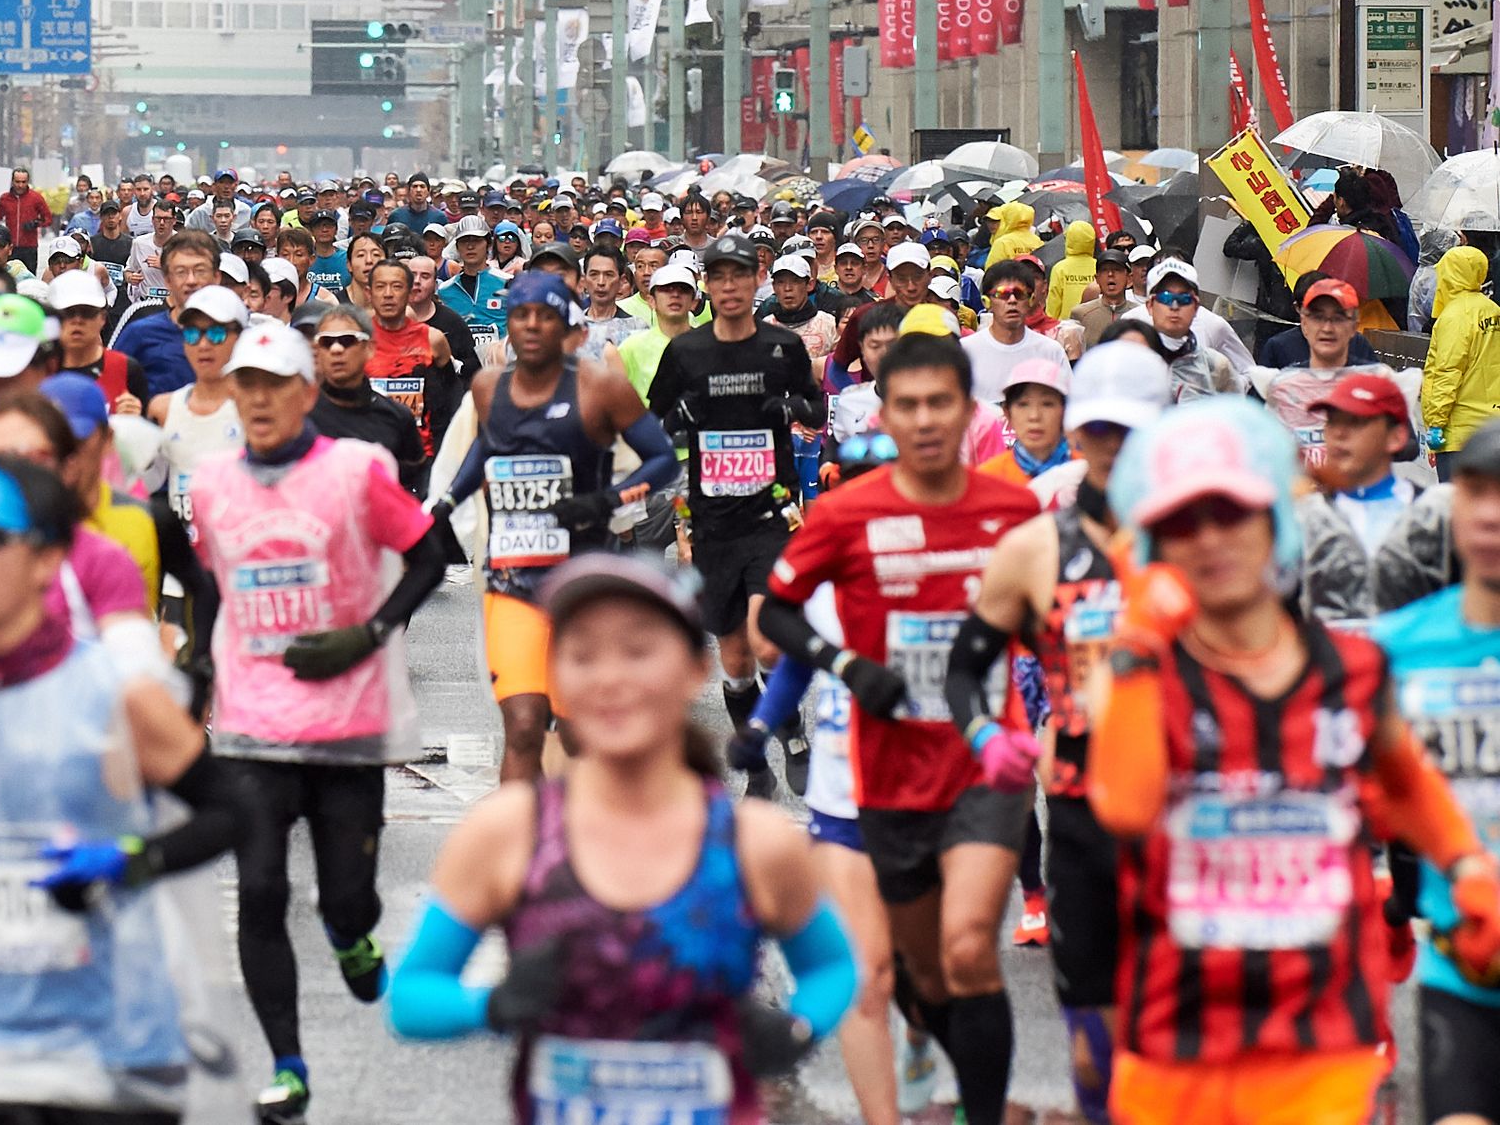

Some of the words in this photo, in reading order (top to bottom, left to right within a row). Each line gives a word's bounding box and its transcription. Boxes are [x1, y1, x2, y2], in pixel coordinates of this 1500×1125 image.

[1367, 25, 1416, 35] 日本橋三越
[388, 381, 420, 390] 東京メトロ
[708, 373, 765, 386] MIDNIGHT
[708, 385, 766, 396] RUNNERS
[723, 434, 766, 447] 東京メトロ
[701, 450, 765, 476] C75220
[498, 532, 561, 553] DAVID
